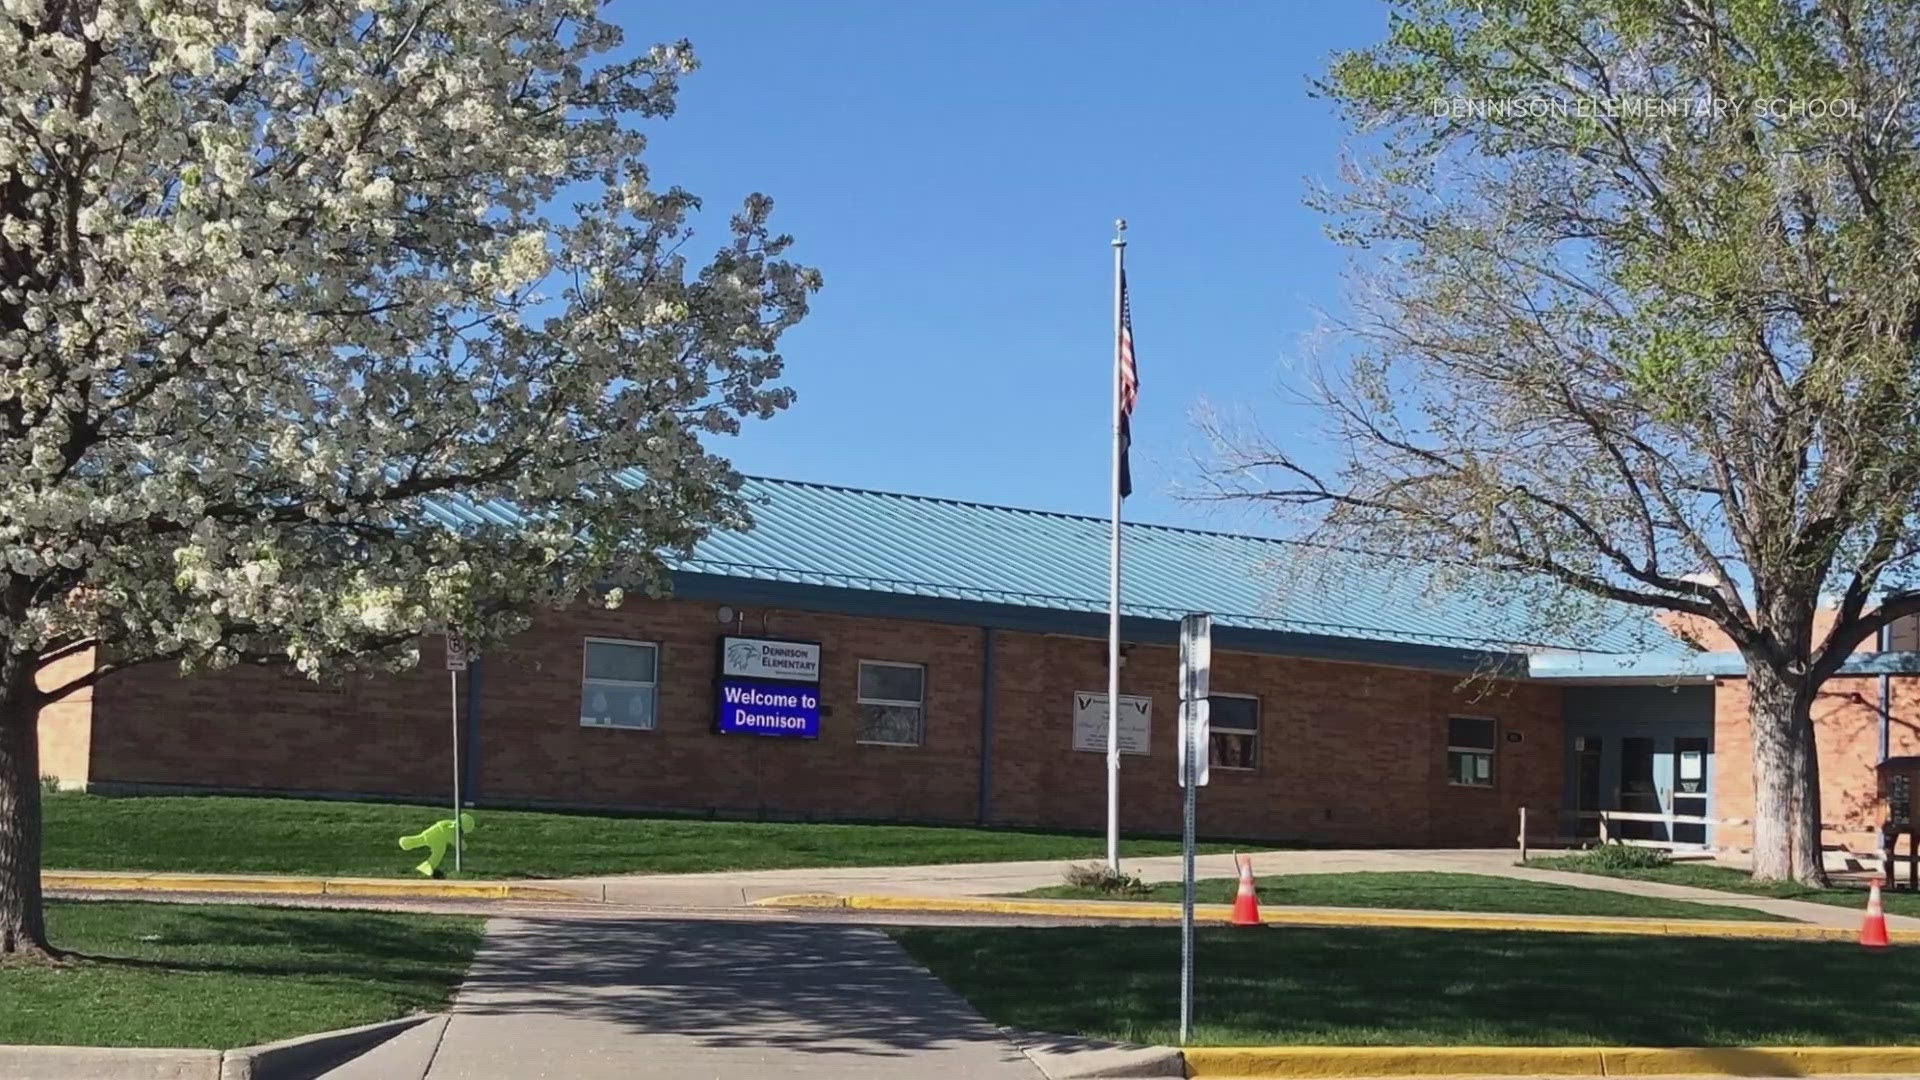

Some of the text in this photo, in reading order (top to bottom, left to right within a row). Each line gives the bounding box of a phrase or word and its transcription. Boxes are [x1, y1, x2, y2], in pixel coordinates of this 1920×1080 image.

[762, 645, 808, 658] DENNISON
[762, 657, 816, 670] ELEMENTARY
[724, 687, 816, 708] Welcome to
[735, 709, 806, 729] Dennison
